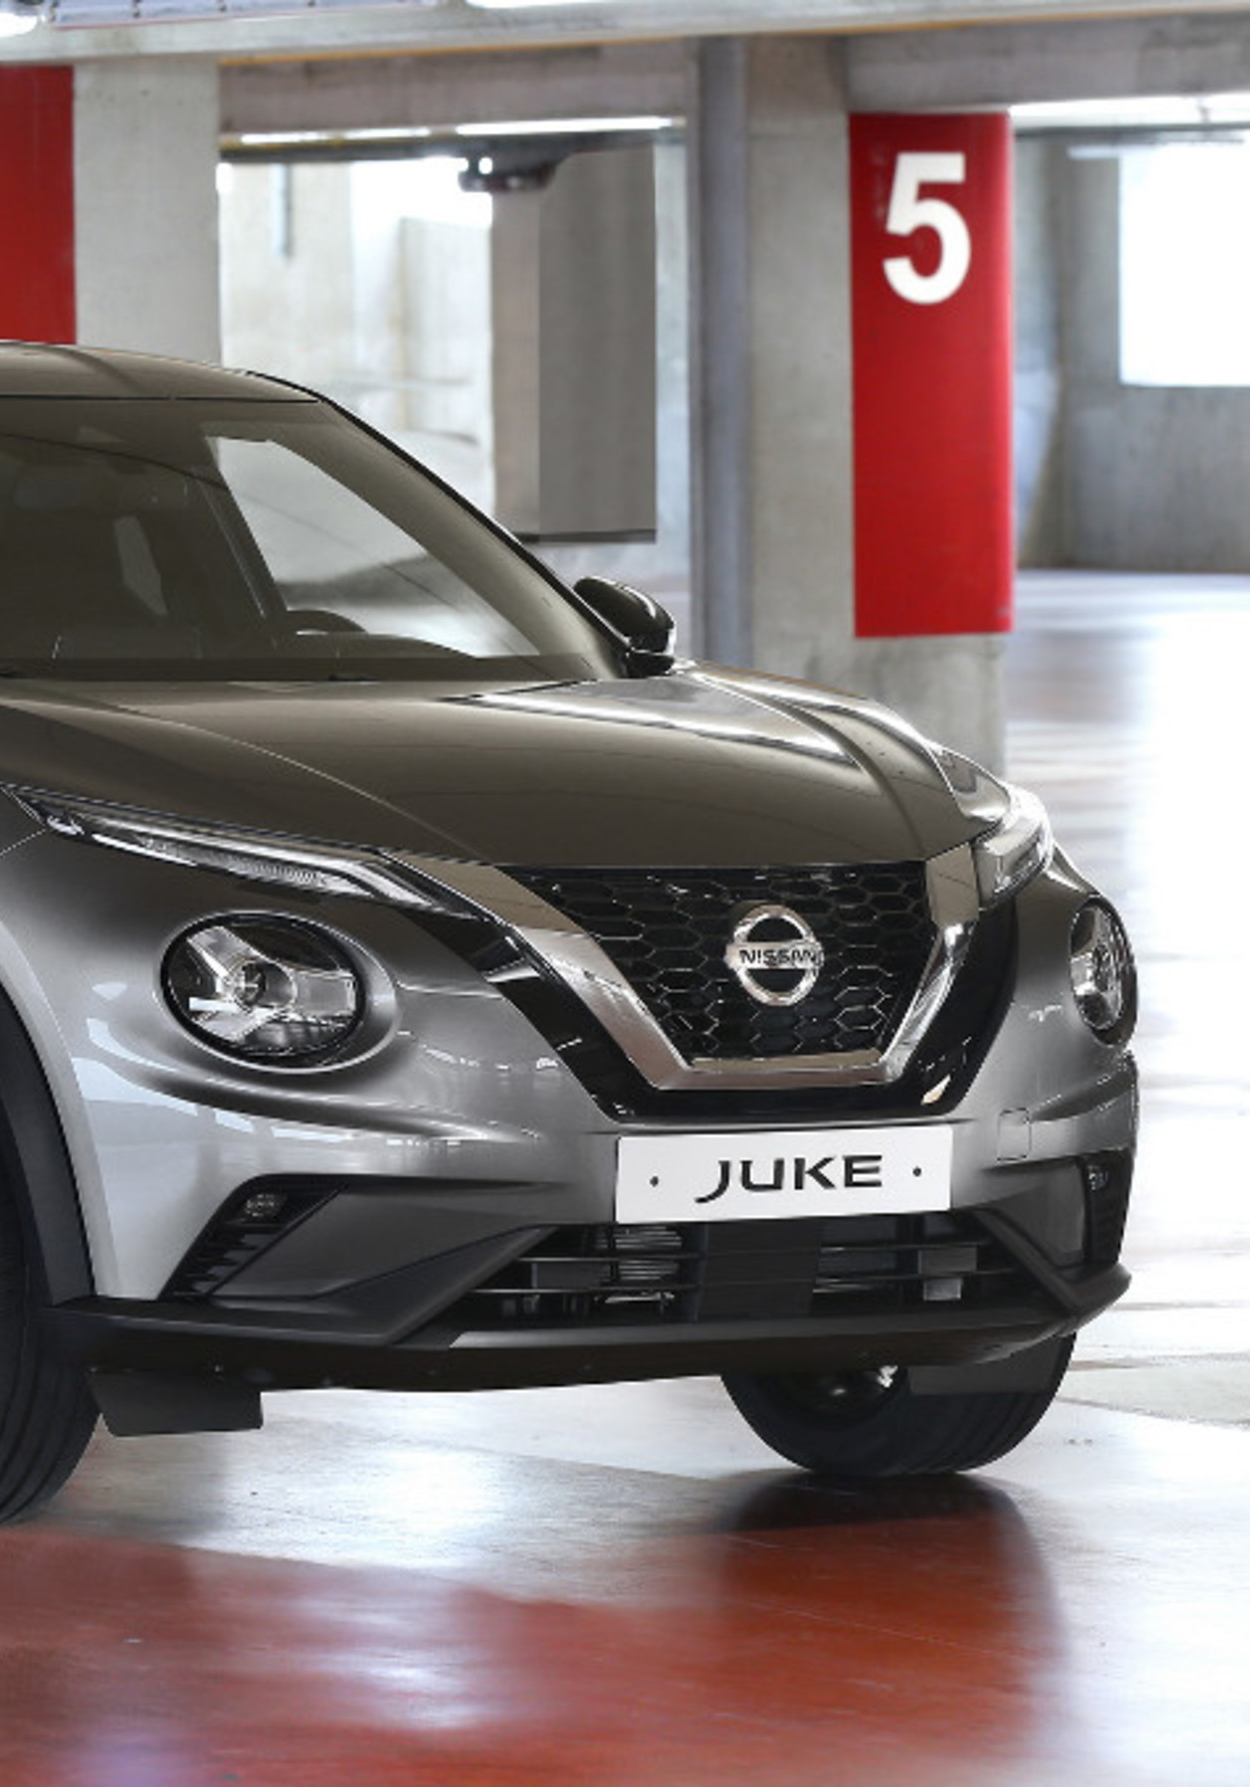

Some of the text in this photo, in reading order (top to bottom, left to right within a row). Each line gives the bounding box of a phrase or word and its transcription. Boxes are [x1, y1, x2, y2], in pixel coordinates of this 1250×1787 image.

[883, 152, 972, 305] 5
[738, 948, 817, 966] NISSAN
[695, 1155, 882, 1203] JUKE
